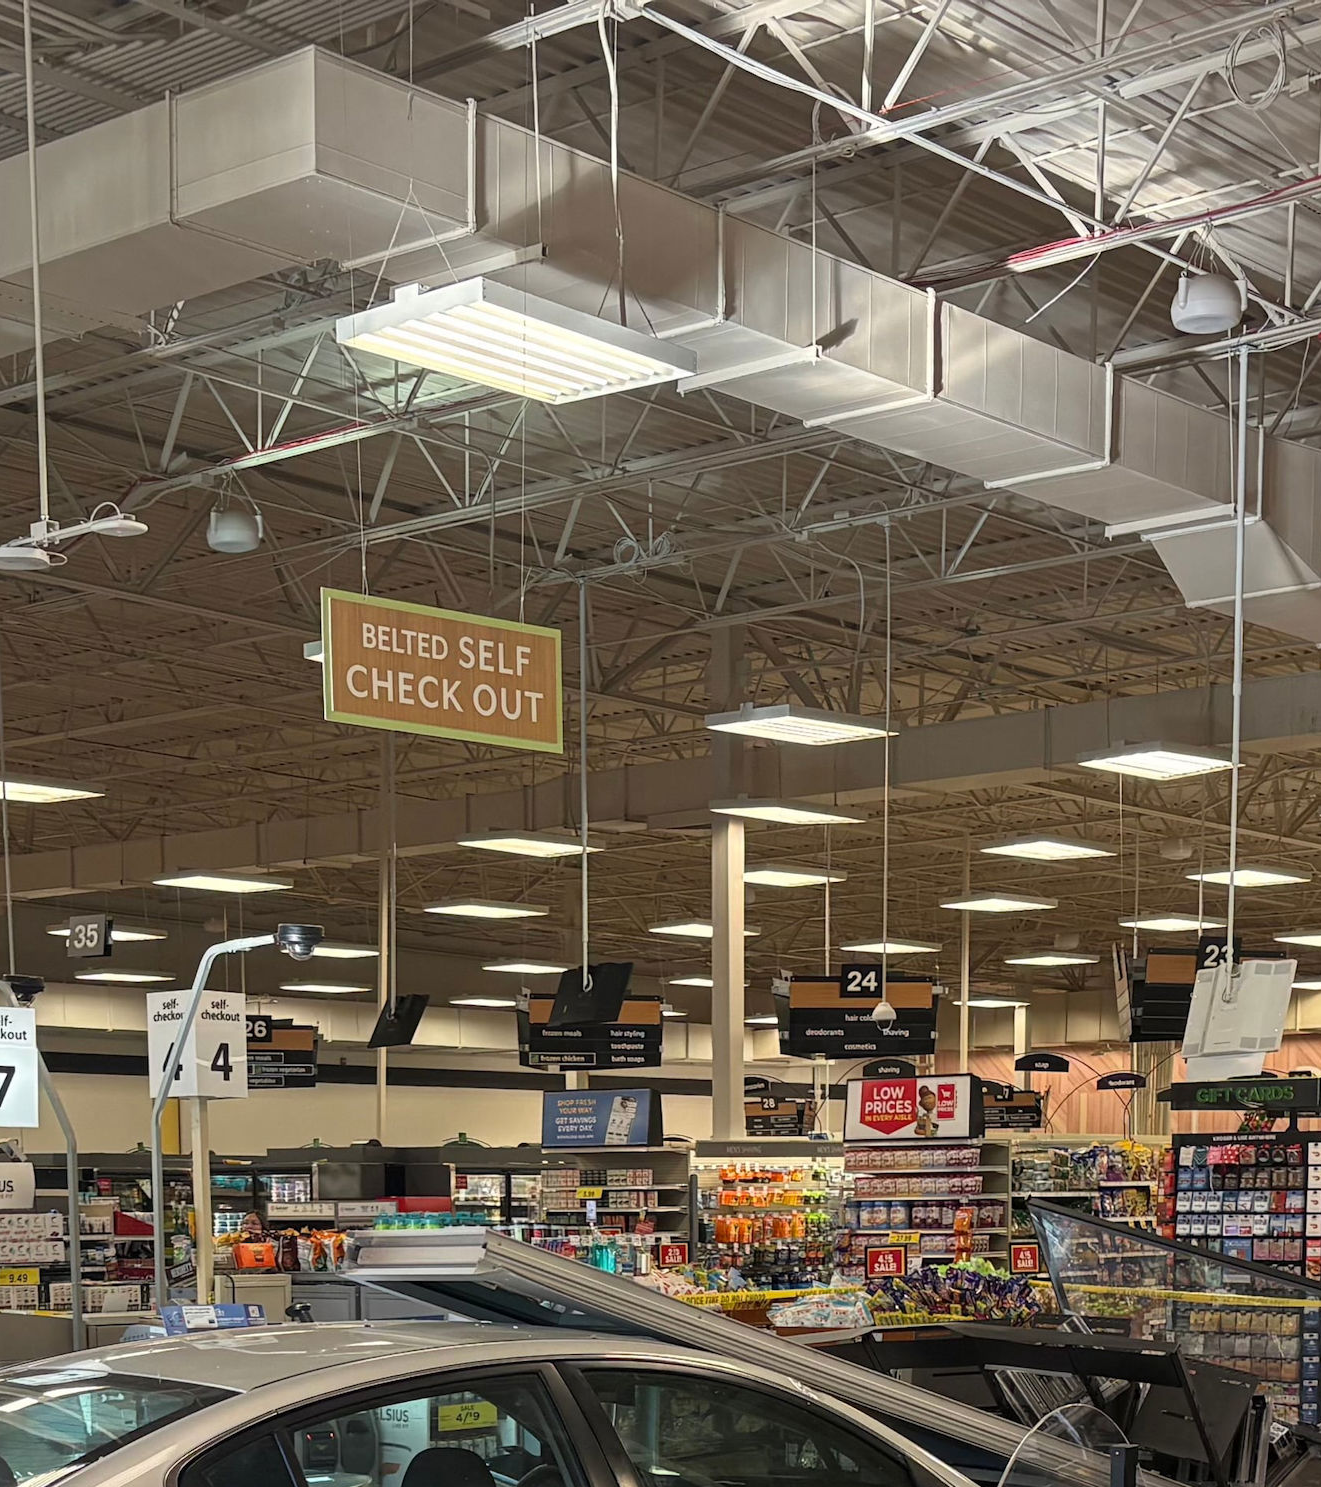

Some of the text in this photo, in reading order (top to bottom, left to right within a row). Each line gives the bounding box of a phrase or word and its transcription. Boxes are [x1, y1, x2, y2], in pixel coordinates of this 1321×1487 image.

[362, 622, 531, 676] BELTED SELF
[346, 664, 544, 722] CHECK OUT
[73, 923, 99, 948] 35
[847, 971, 878, 992] 24
[162, 999, 179, 1010] self-
[210, 999, 229, 1010] self-
[200, 1010, 240, 1023] checkout
[246, 1020, 268, 1038] 26
[805, 1028, 844, 1037] deodorants
[844, 1043, 876, 1051] cosmetics
[210, 1043, 233, 1081] 4
[873, 1086, 905, 1100] LOW
[1196, 1086, 1294, 1103] GIFT CARDS
[762, 1098, 776, 1109] 28
[865, 1100, 912, 1114] PRICES
[872, 1114, 892, 1122] EVERY
[894, 1113, 913, 1121] AISLE
[873, 1262, 897, 1273] SALE!
[8, 1272, 28, 1283] 9.49
